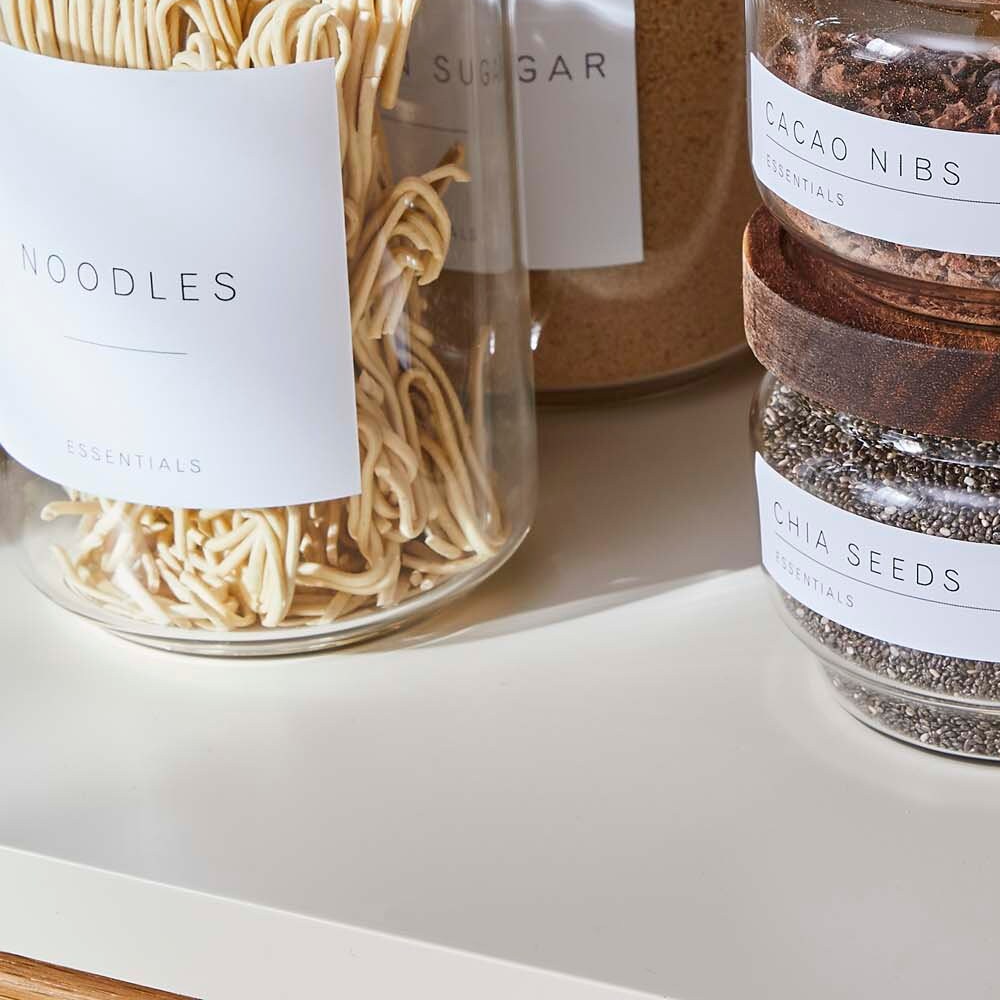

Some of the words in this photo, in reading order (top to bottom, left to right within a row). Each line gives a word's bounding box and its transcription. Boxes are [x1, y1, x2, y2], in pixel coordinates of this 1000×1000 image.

[765, 100, 848, 161] CACAO
[870, 147, 961, 186] NIBS
[765, 153, 845, 207] ESSENTIALS
[20, 242, 238, 303] NOODLES
[66, 438, 203, 474] ESSENTIALS
[772, 500, 830, 555] CHIA
[846, 542, 961, 593] SEEDS
[774, 551, 855, 609] ESSENTIALS
